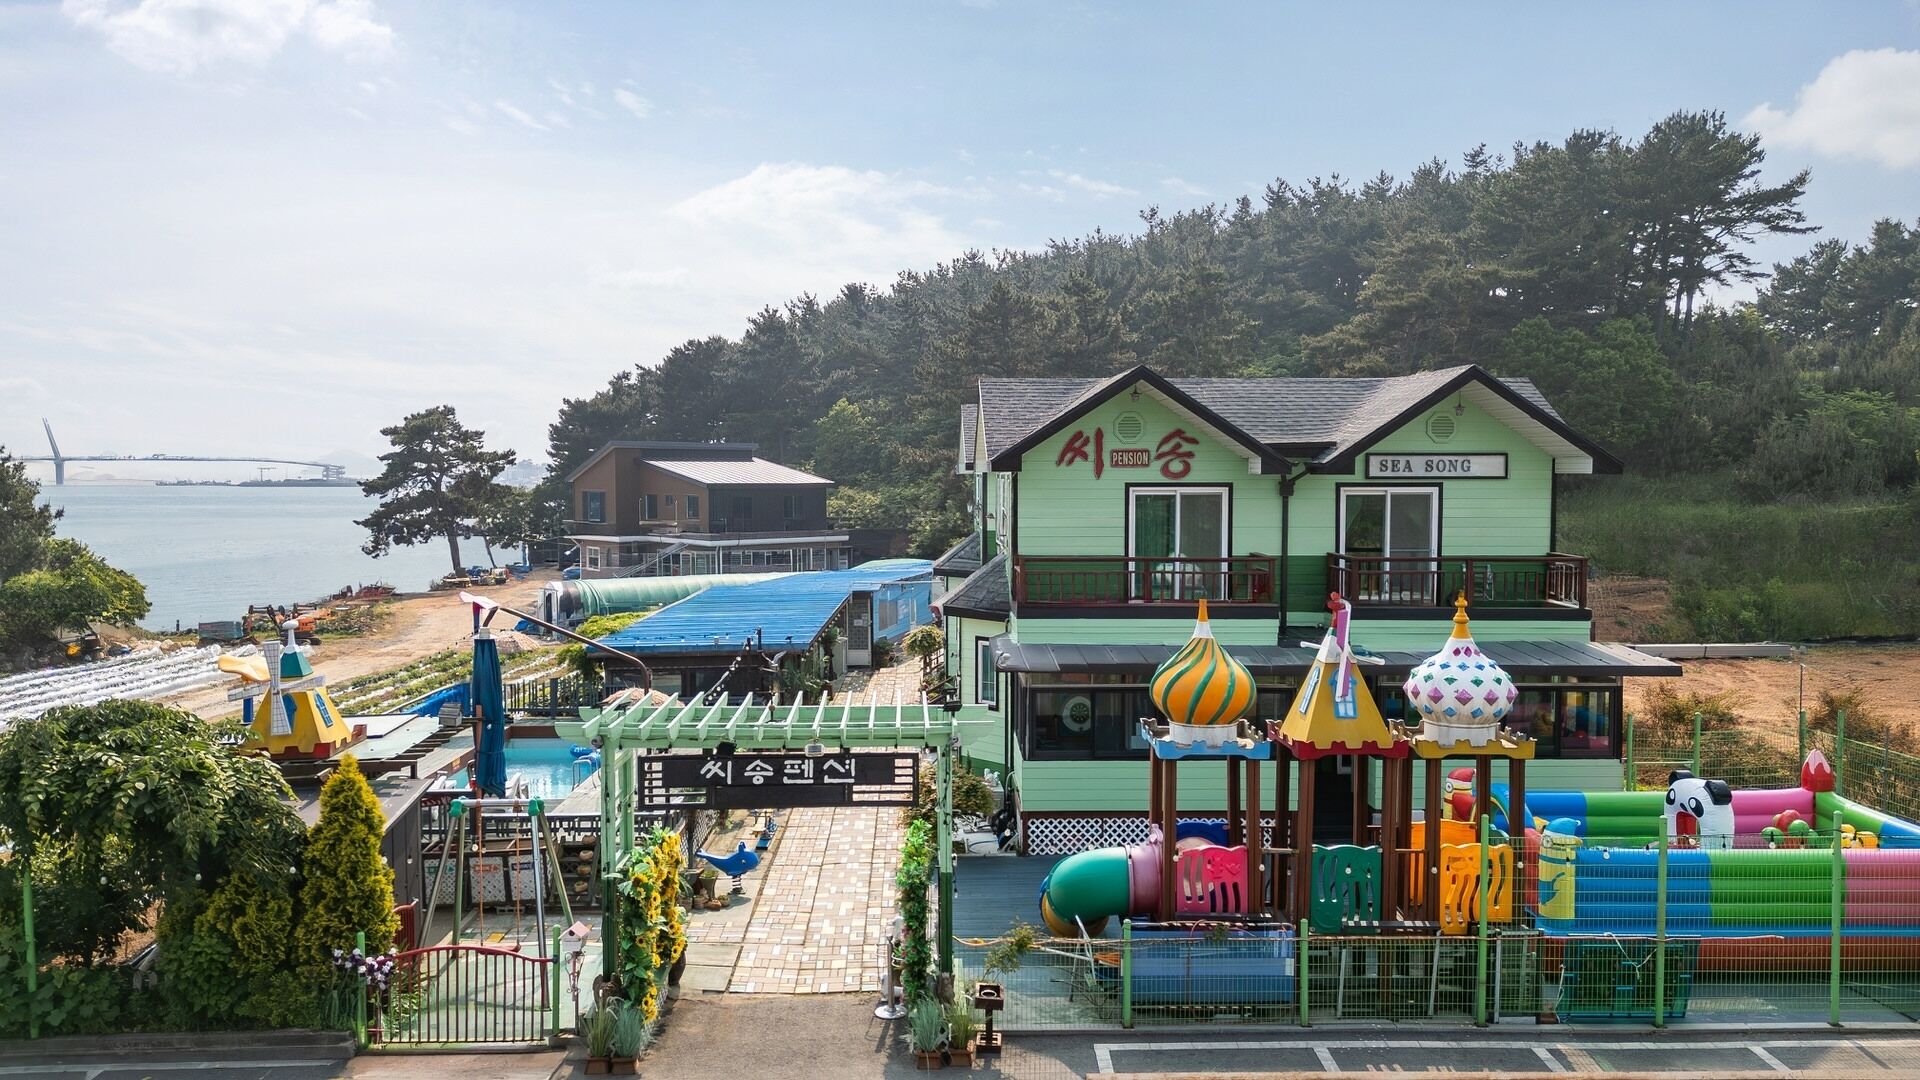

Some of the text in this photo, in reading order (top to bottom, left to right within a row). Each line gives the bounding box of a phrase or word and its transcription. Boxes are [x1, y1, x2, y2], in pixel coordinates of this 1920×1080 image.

[1056, 427, 1200, 480] 씨 송
[1112, 451, 1149, 465] PENSION
[1379, 460, 1472, 473] SEA SONG
[700, 758, 855, 785] 씨송펜션
